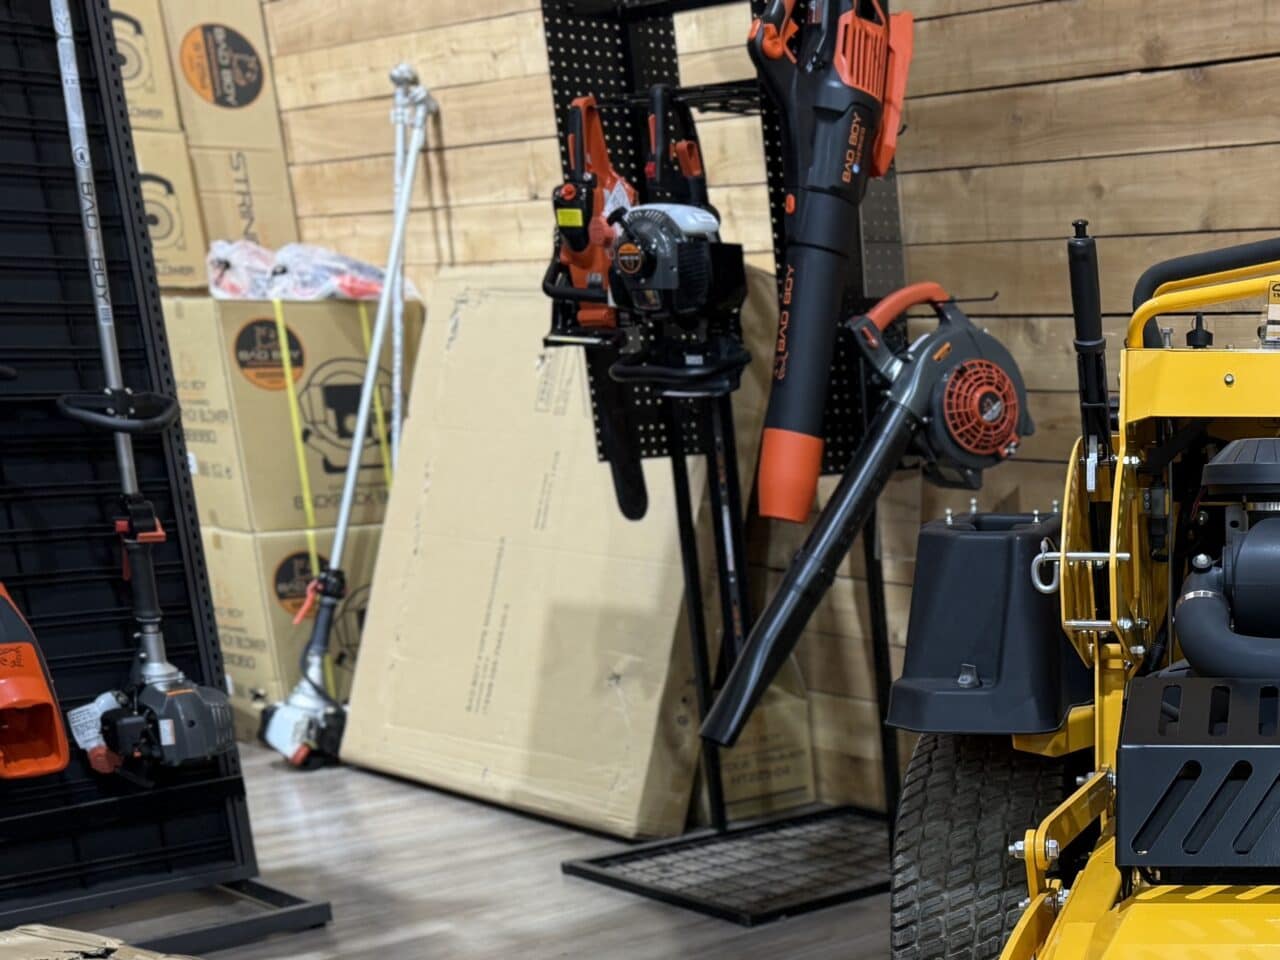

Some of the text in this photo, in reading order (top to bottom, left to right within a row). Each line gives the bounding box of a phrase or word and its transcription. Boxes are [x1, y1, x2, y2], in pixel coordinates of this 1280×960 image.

[848, 112, 863, 146] BOY
[842, 149, 855, 183] BAD
[79, 181, 98, 231] BAD
[228, 151, 260, 244] STRIN
[778, 264, 796, 351] BAD BOY
